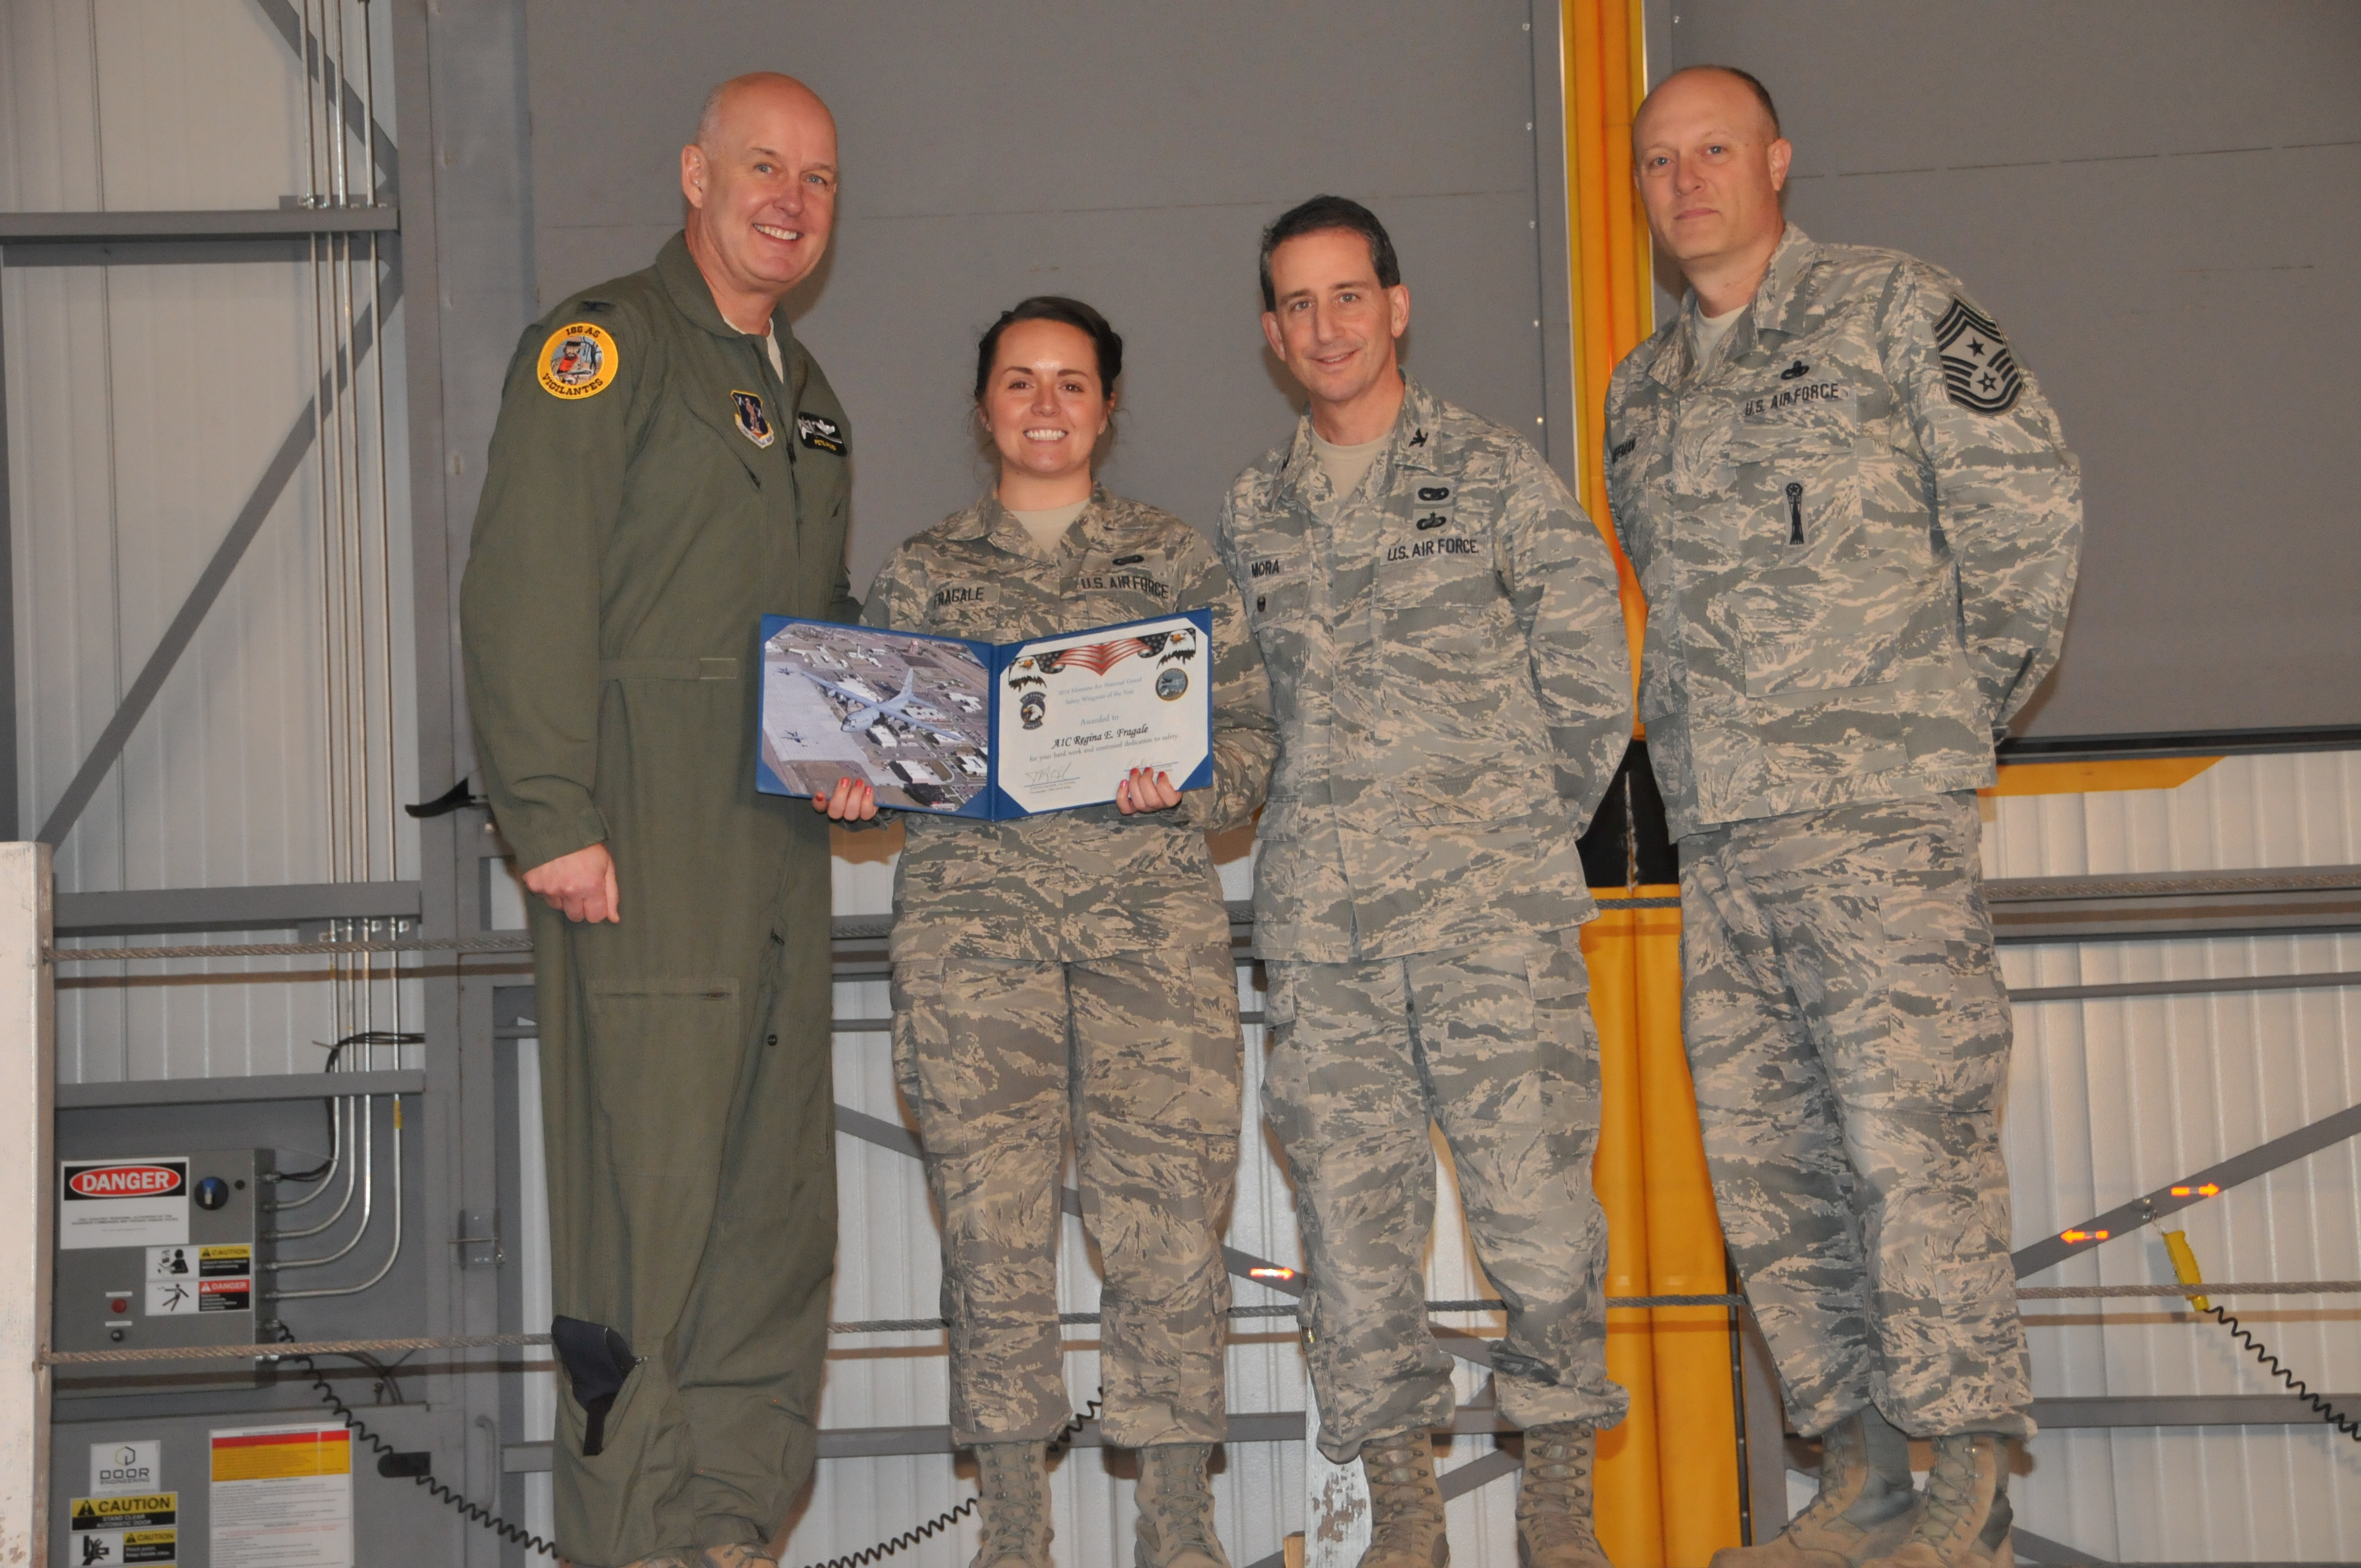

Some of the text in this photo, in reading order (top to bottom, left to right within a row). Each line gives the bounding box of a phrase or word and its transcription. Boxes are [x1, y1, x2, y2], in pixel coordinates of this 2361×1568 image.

[566, 325, 601, 337] 186 AS
[542, 373, 603, 395] VIGILANTES
[1745, 383, 1839, 416] U.S. AIR FORCE
[1387, 538, 1479, 561] U.S. AIR FORCE
[1251, 559, 1280, 579] MORA
[1081, 575, 1169, 599] U.S. AIR FORCE
[934, 587, 984, 609] FRAGALE
[1104, 679, 1125, 688] National
[1080, 714, 1109, 726] Awarded
[1051, 723, 1149, 749] A1C Regina E. Fragale
[1054, 750, 1066, 758] hard
[1096, 741, 1122, 751] continued
[1124, 738, 1152, 747] dedication
[1162, 733, 1180, 741] safety.
[82, 1171, 170, 1192] DANGER
[211, 1248, 248, 1256] CAUTION
[211, 1281, 247, 1290] DANGER
[100, 1468, 150, 1479] DOOR
[98, 1497, 170, 1513] CAUTION
[137, 1533, 174, 1541] CAUTION
